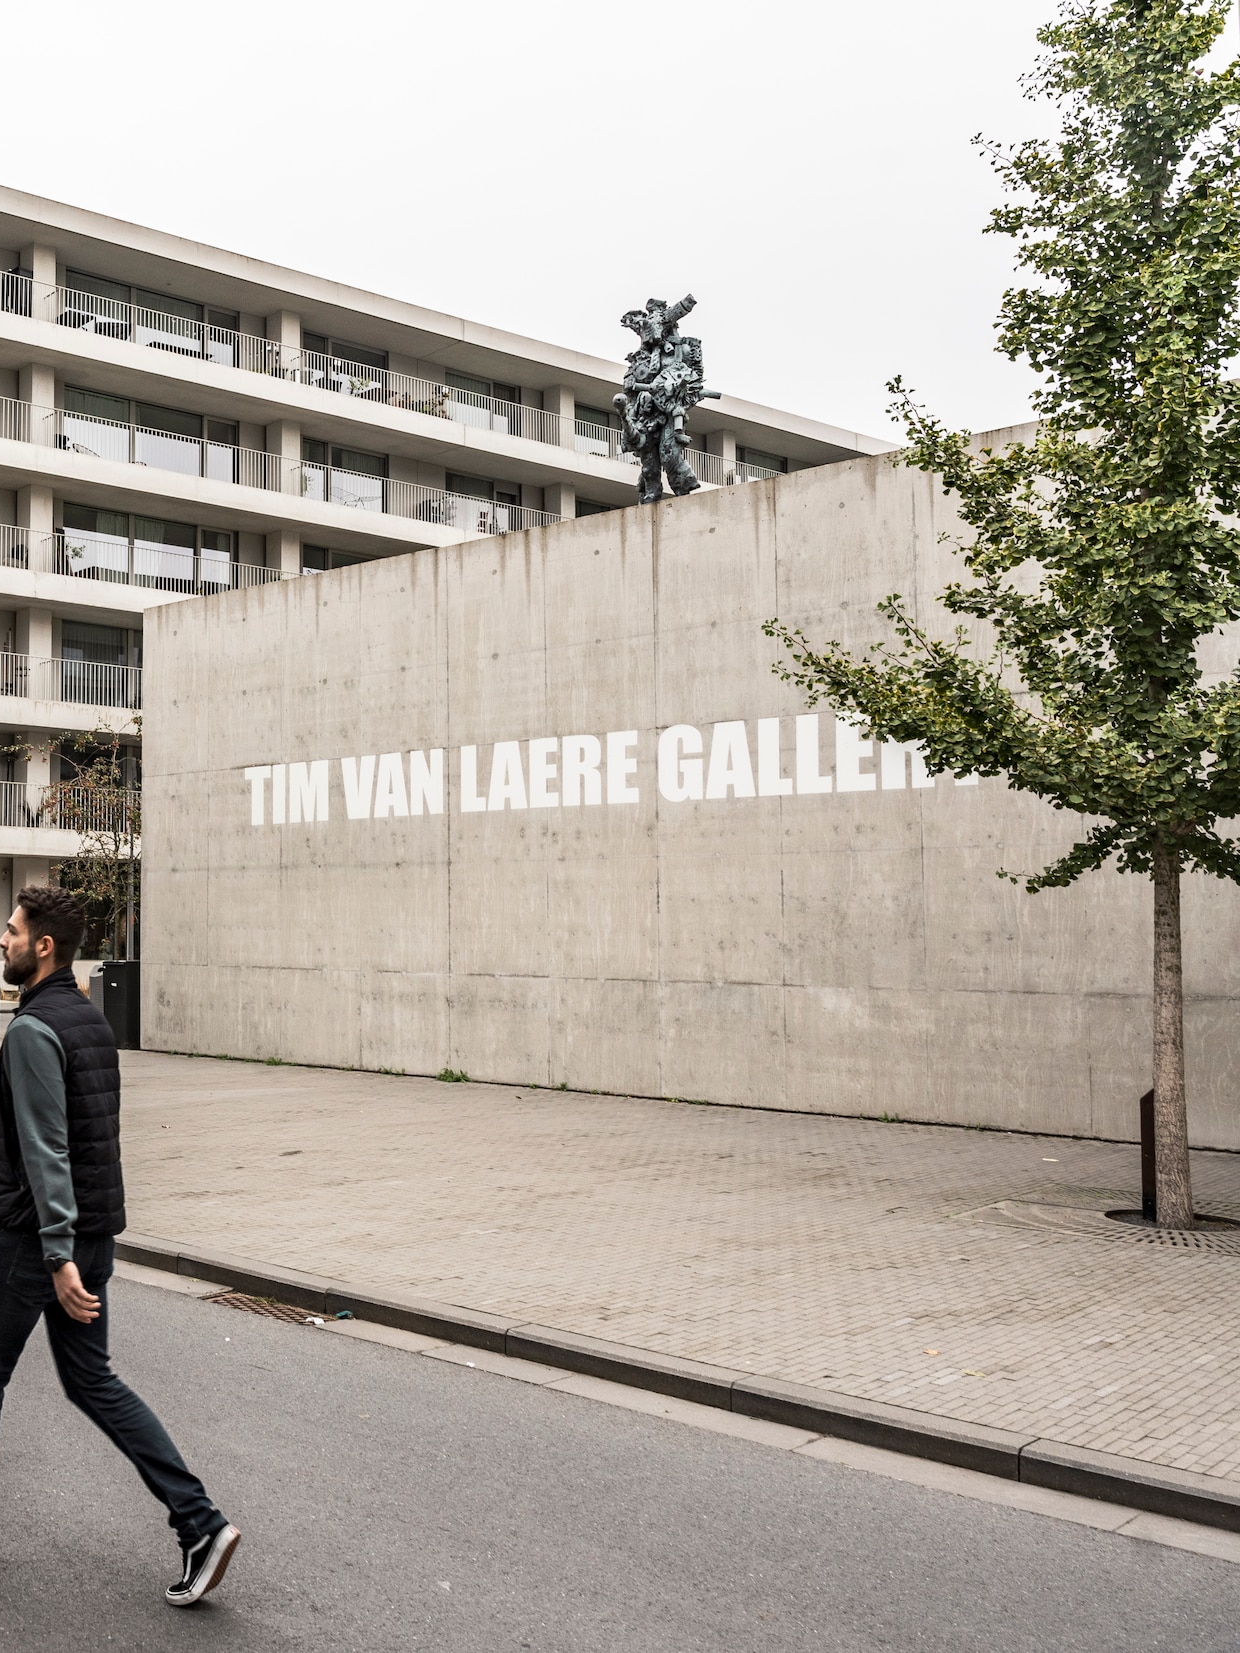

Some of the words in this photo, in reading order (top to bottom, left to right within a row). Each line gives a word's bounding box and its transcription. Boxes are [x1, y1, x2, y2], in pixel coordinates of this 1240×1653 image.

[245, 759, 328, 825] TIM
[341, 748, 443, 819] VAN
[460, 730, 639, 812] LAERE
[658, 710, 979, 802] GALLER
